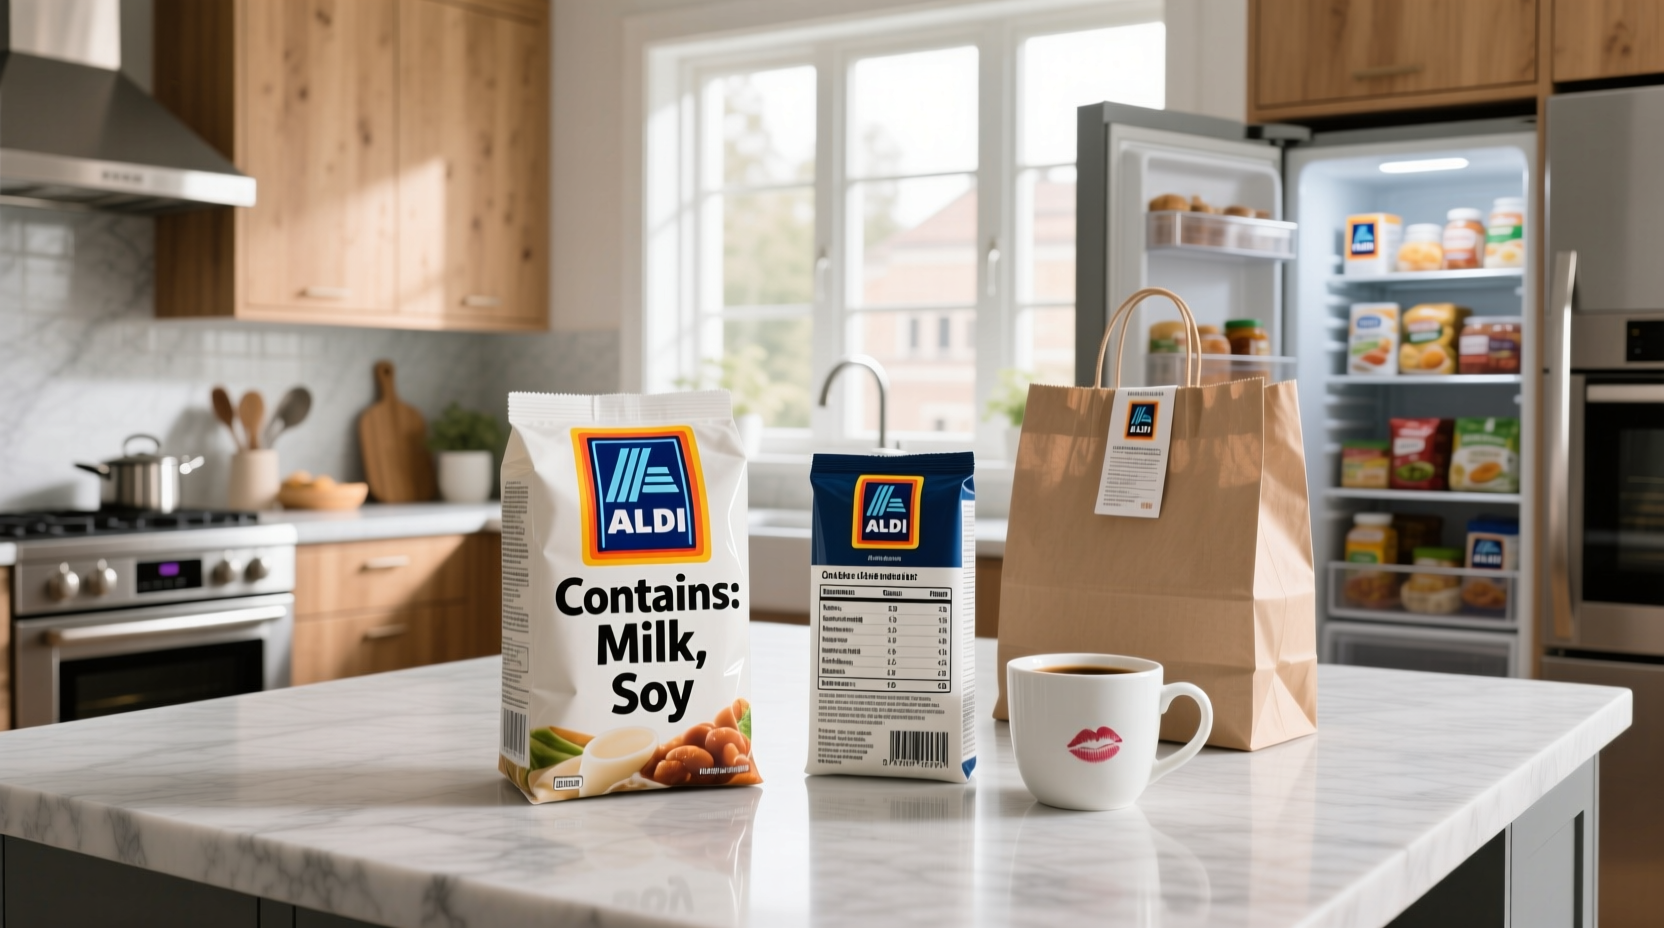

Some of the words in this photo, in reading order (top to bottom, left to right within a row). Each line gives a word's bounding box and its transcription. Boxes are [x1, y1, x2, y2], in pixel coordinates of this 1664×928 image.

[607, 508, 686, 534] ALDI
[865, 518, 907, 534] ALDI
[555, 574, 740, 617] Contains:
[597, 619, 707, 670] Milk,
[611, 672, 695, 724] Soy
